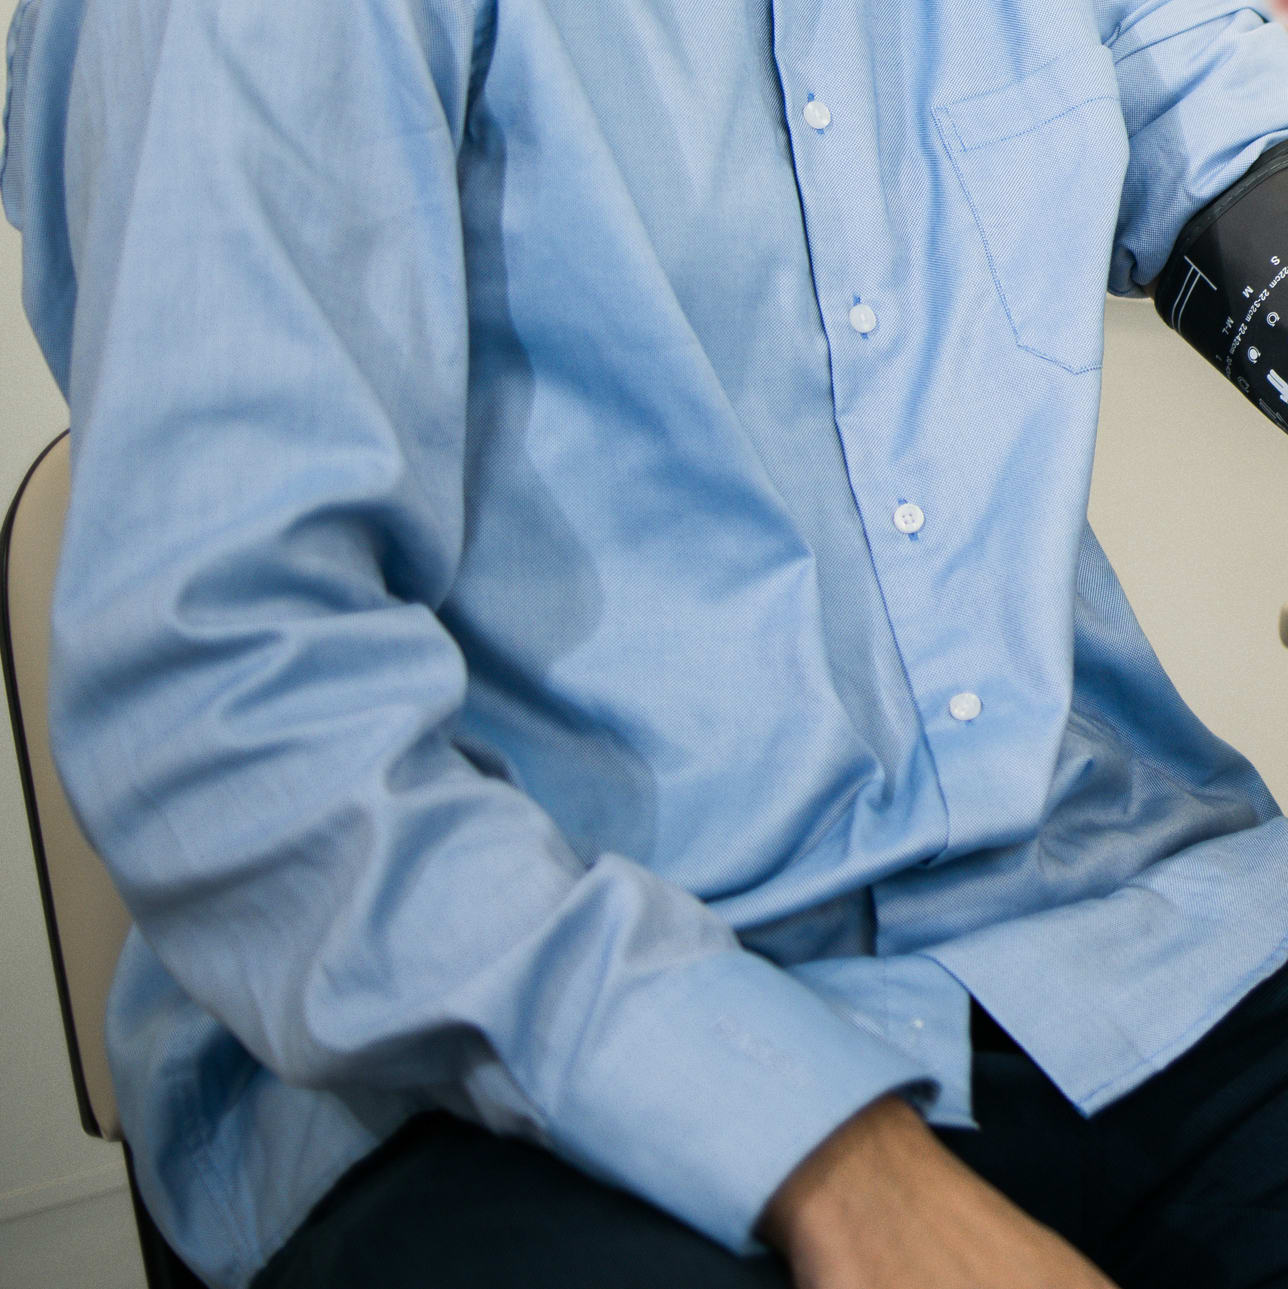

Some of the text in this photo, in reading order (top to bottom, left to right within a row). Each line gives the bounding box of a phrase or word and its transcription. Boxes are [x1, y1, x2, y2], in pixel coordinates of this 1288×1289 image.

[1270, 255, 1280, 266] S
[1242, 285, 1254, 299] M
[1245, 289, 1270, 322] 22-32cm
[1222, 316, 1234, 335] M-L
[1229, 323, 1248, 355] 22-42cm
